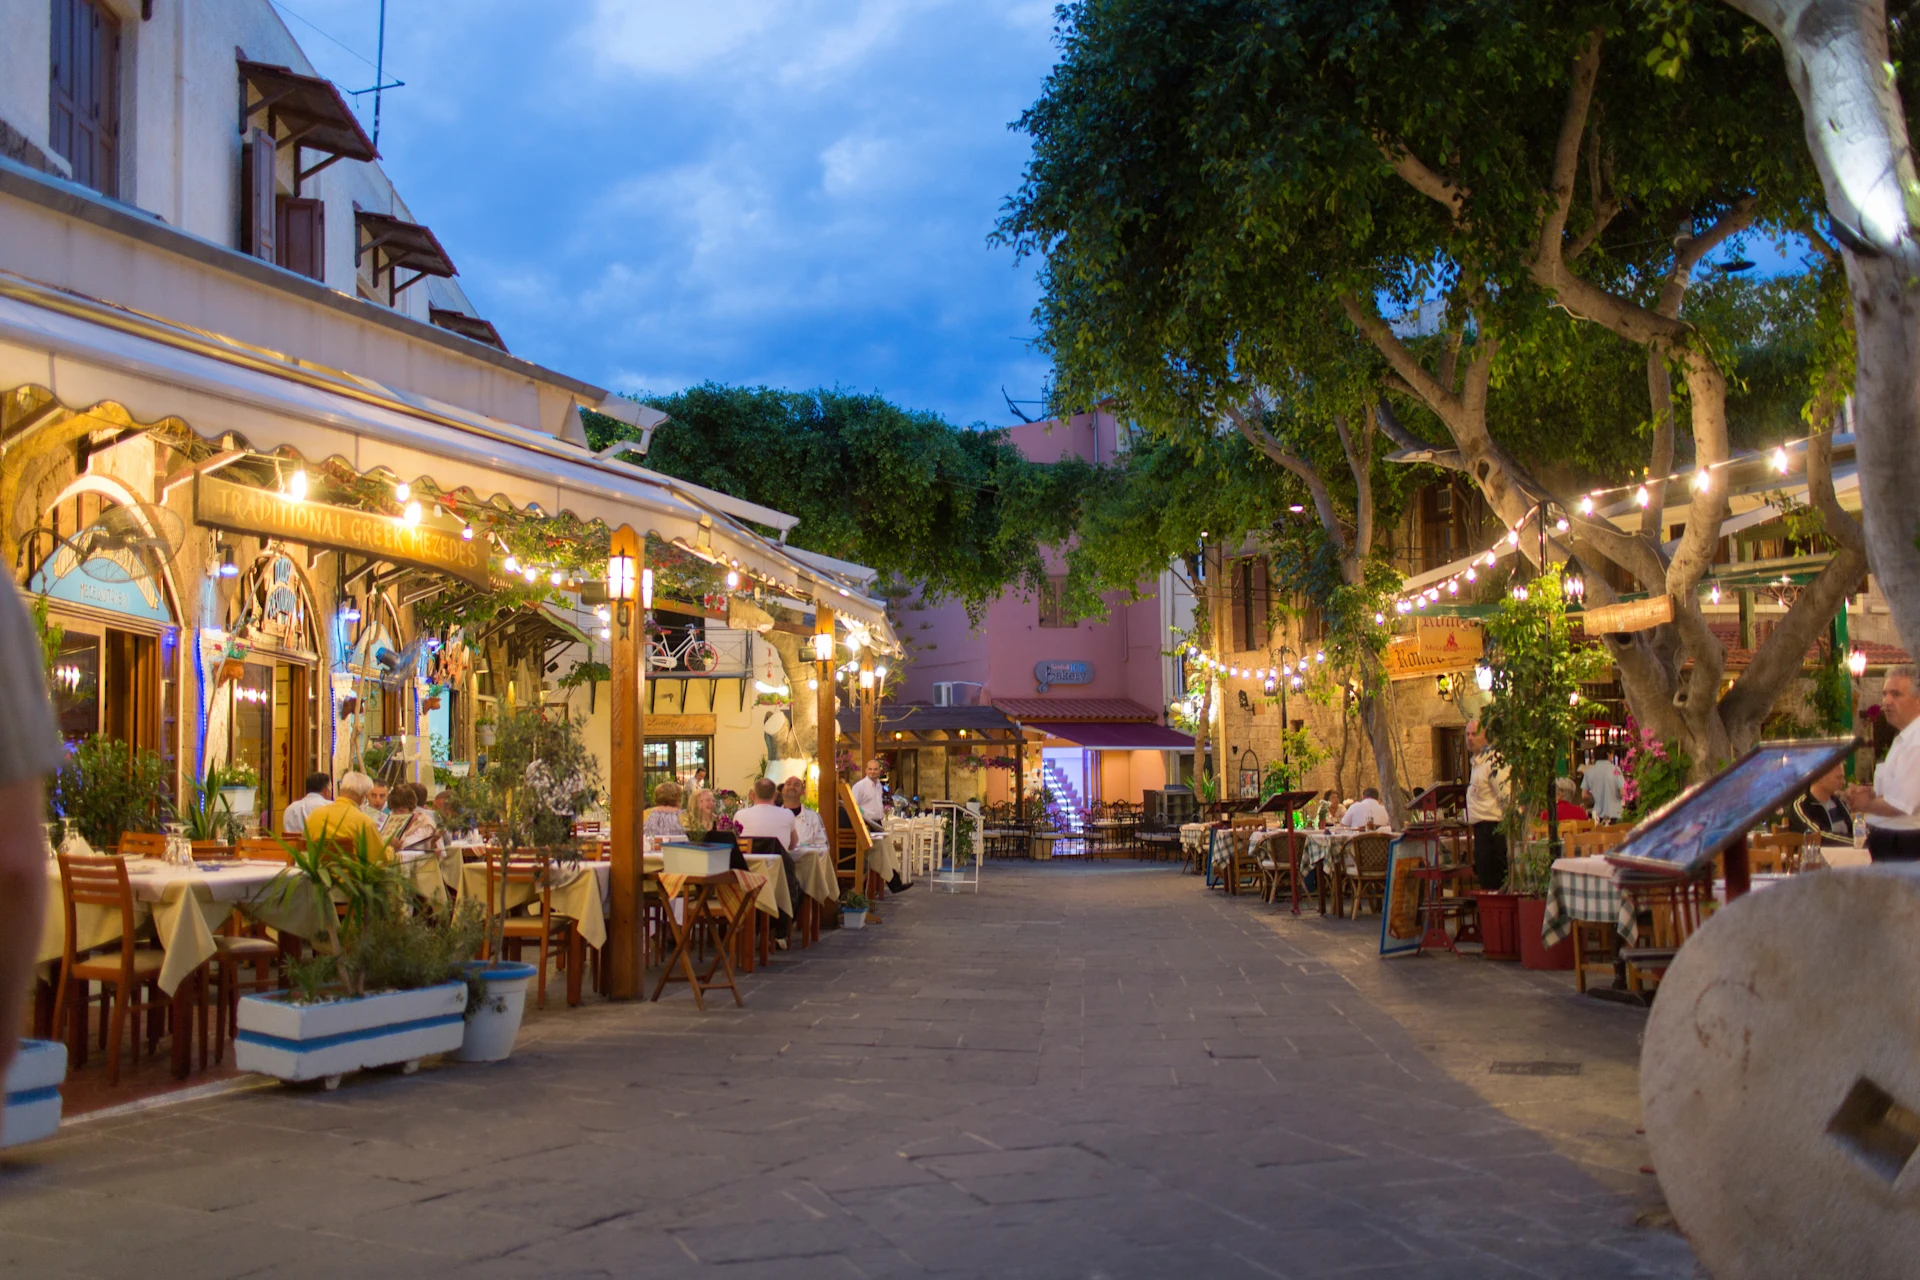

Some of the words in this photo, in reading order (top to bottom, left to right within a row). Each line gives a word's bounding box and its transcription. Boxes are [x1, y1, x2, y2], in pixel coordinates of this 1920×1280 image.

[216, 488, 345, 539] TRADITIONAL
[351, 517, 405, 552] GREEK
[411, 529, 479, 568] MEZEDES
[1042, 665, 1086, 687] Bakery
